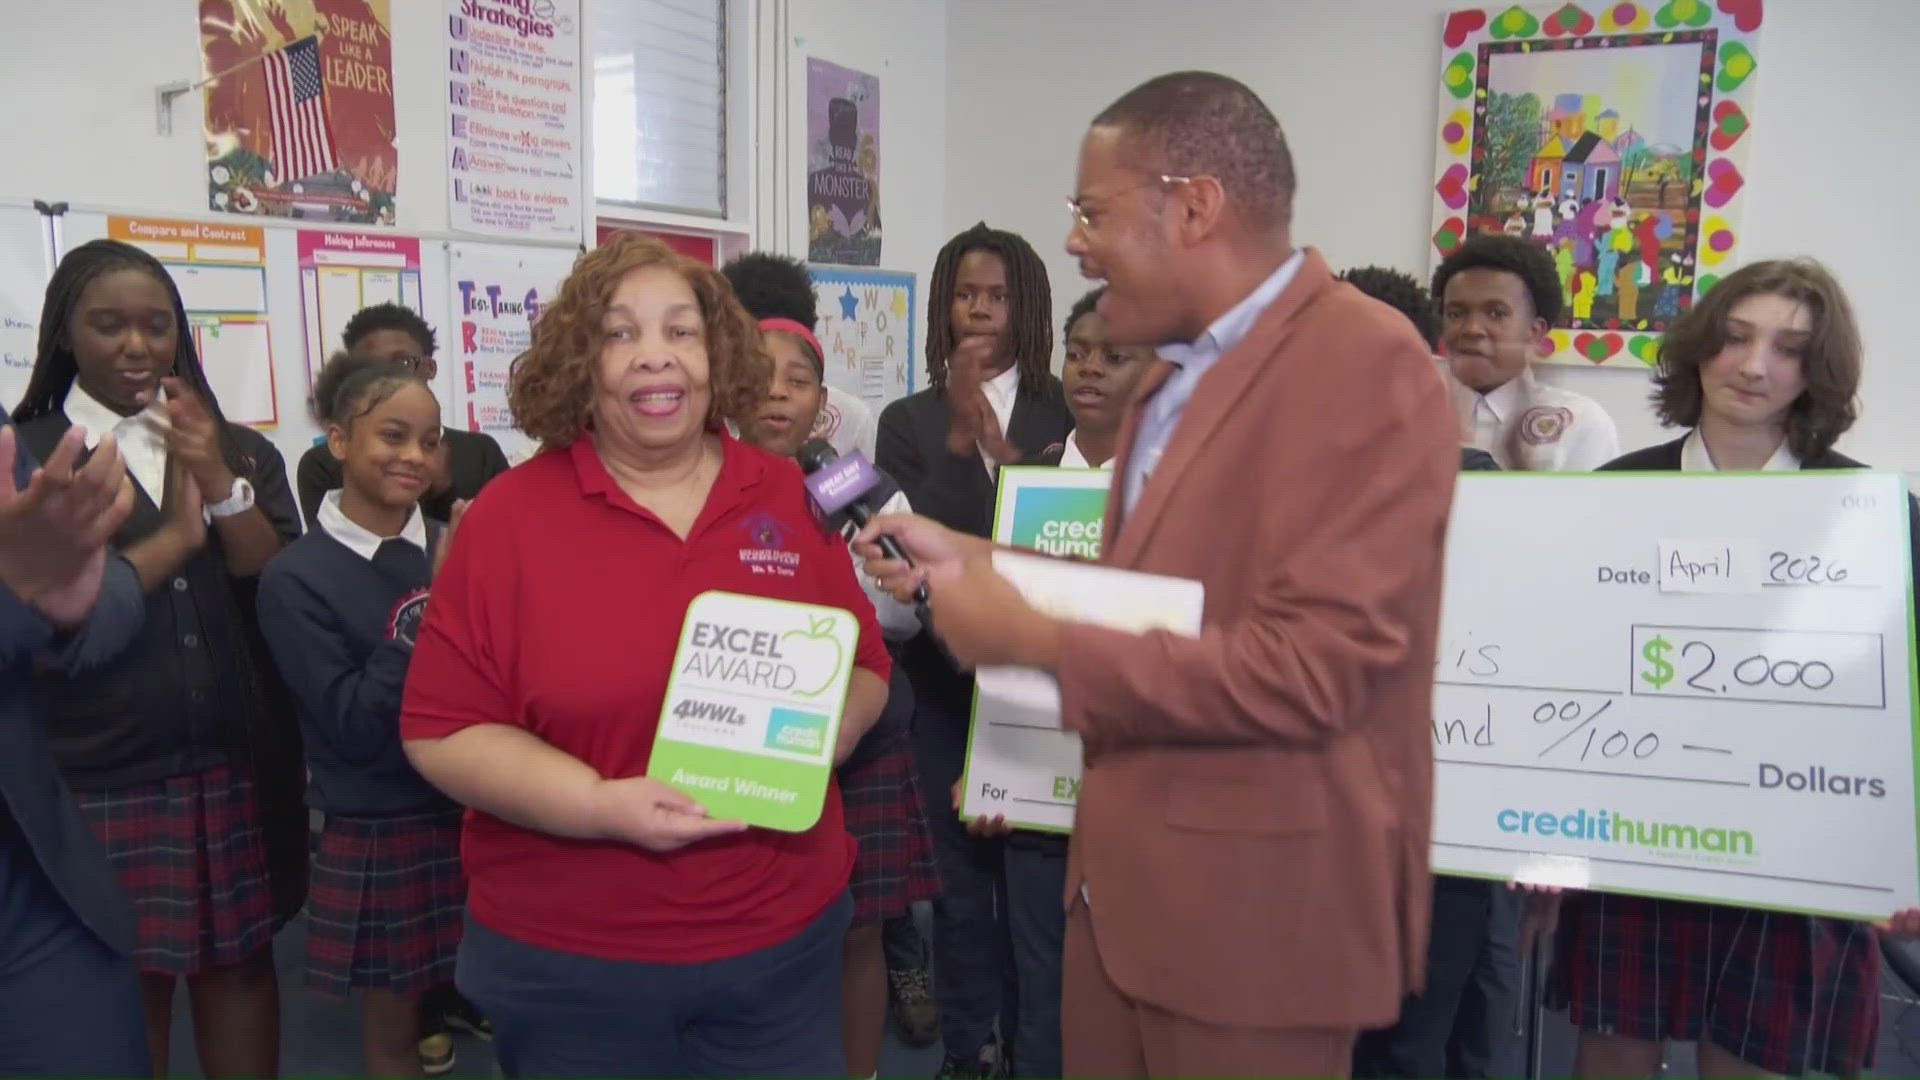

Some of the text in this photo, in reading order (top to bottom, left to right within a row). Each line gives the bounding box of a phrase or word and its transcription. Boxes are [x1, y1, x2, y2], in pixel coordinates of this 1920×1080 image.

[331, 12, 379, 47] SPEAK
[461, 0, 554, 38] Strategies
[340, 41, 373, 62] LIKE A
[326, 55, 391, 96] LEADER
[512, 96, 550, 111] questions
[469, 121, 510, 140] Eliminate
[469, 153, 505, 171] Answer
[470, 183, 492, 197] Look
[496, 185, 518, 201] back
[520, 190, 531, 202] for
[814, 172, 870, 201] MONSTER
[129, 220, 247, 241] Compare and Contrast
[324, 233, 396, 250] Making Inferences
[1597, 566, 1651, 586] Date
[1669, 547, 1848, 585] April 2026
[691, 621, 783, 659] EXCEL
[682, 652, 797, 691] AWARD
[673, 699, 738, 725] 4WWL
[671, 767, 798, 805] Award Winner
[981, 782, 1008, 801] For
[1758, 763, 1886, 799] Dollars
[1497, 808, 1755, 855] credithuman
